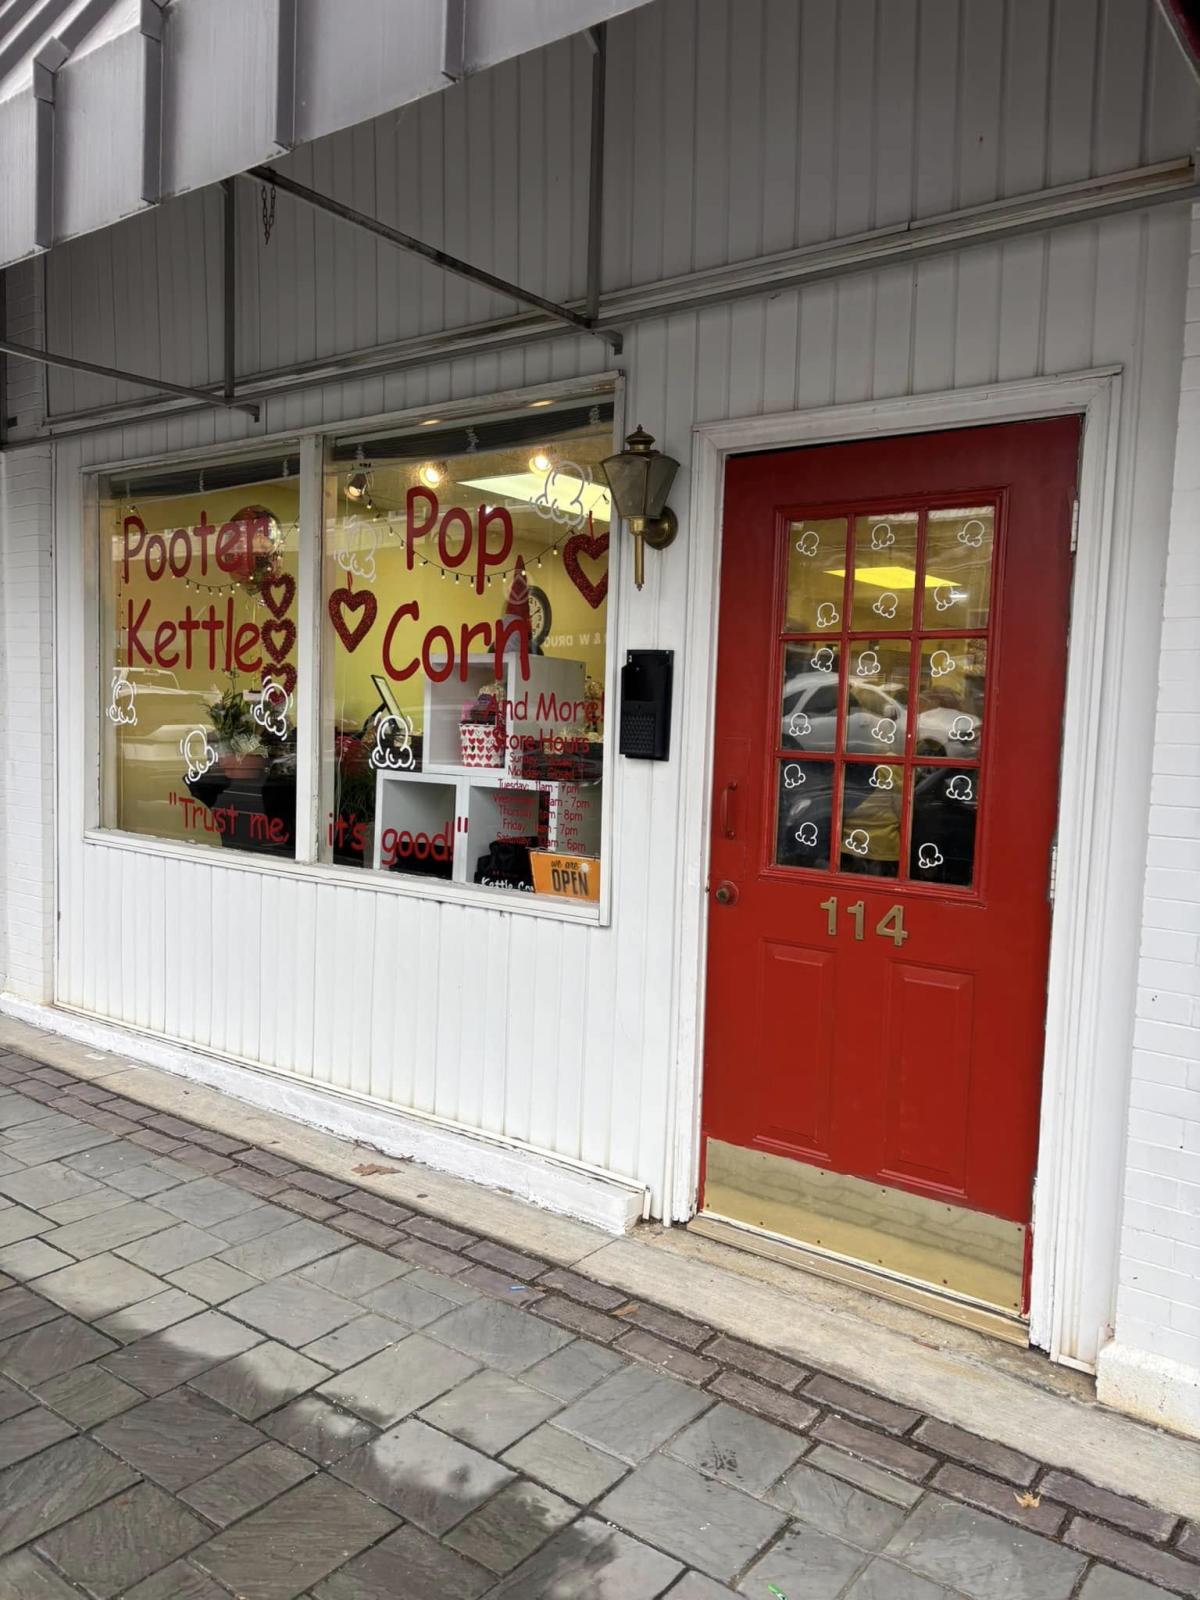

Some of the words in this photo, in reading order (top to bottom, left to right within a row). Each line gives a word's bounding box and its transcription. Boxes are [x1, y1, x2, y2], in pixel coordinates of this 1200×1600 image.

[123, 511, 271, 584] Pooter
[406, 485, 513, 595] Pop
[127, 597, 263, 673] Kettle
[382, 600, 531, 683] Corn
[563, 809, 583, 824] 8pm
[571, 797, 590, 810] 7pm
[169, 792, 239, 834] "Trust
[249, 813, 290, 843] me,
[327, 812, 367, 850] it's
[381, 816, 469, 865] good!"
[559, 823, 578, 837] 7pm
[566, 838, 586, 853] 6pm
[551, 868, 588, 896] OPEN
[820, 896, 908, 946] 114
